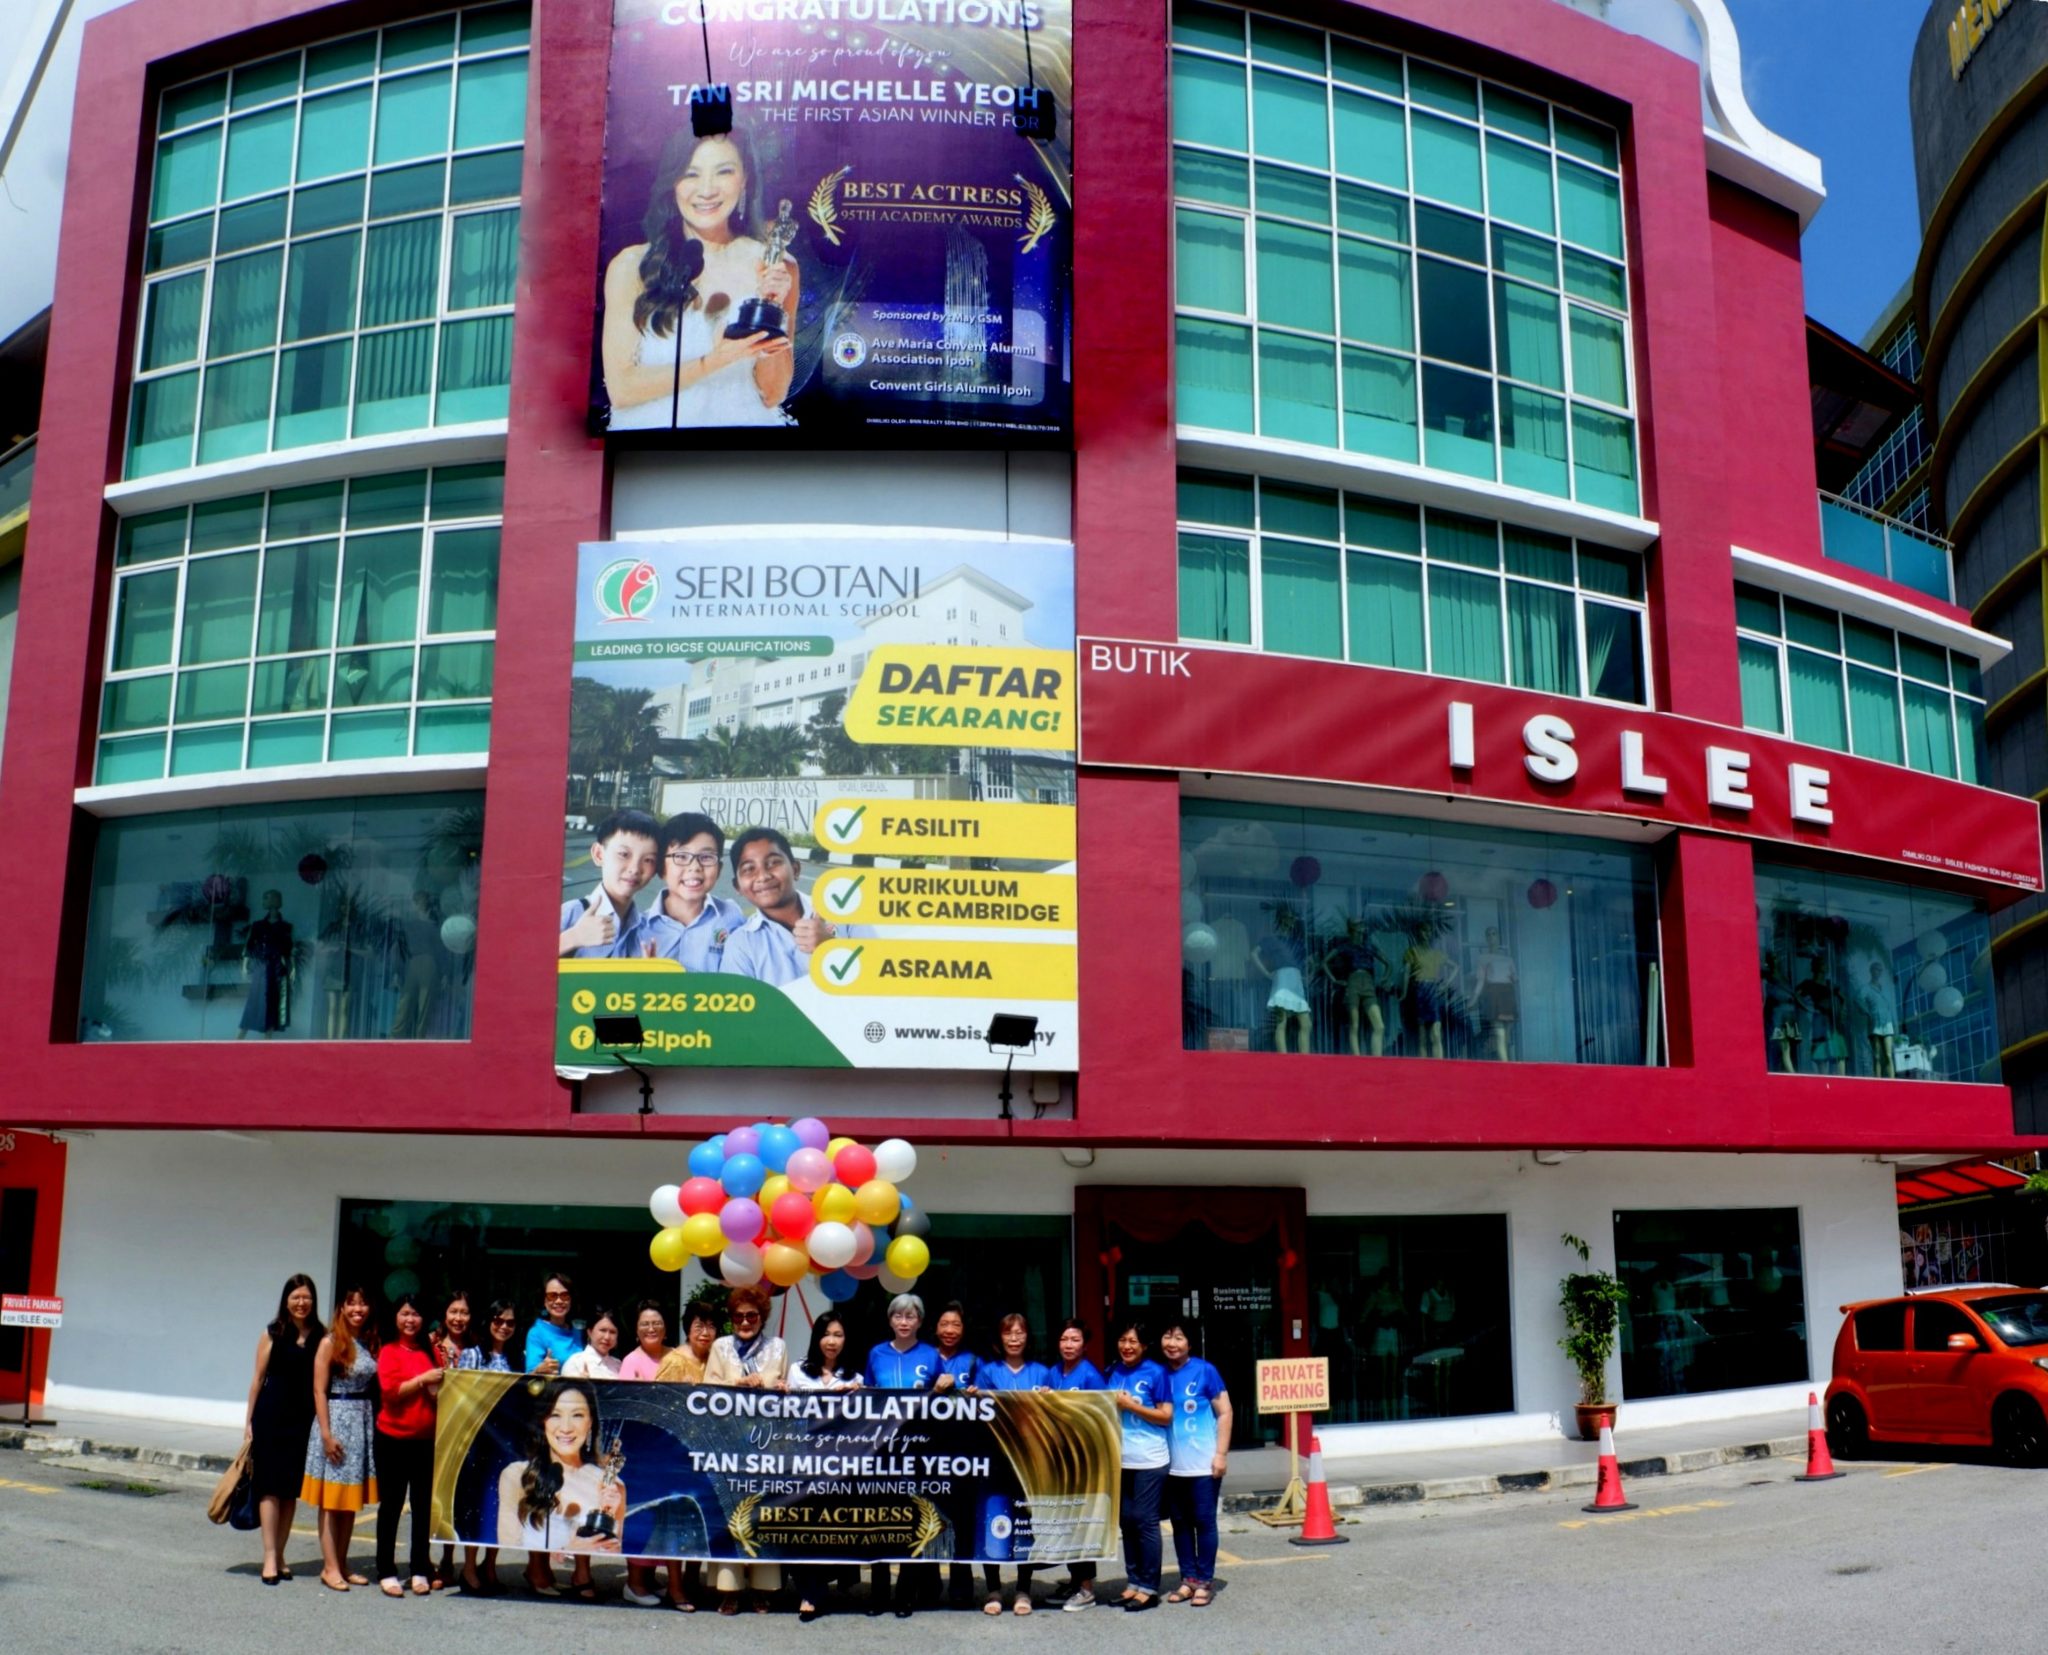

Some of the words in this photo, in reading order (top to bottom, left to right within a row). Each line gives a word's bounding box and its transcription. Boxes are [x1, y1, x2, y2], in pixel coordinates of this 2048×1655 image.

[661, 0, 1040, 27] CONGRATULATIONS
[728, 37, 768, 67] We
[772, 47, 807, 58] are
[808, 46, 829, 63] so
[831, 38, 889, 66] proud
[667, 82, 727, 106] TAN
[736, 80, 783, 102] SRI
[792, 79, 947, 103] MICHELLE
[954, 81, 1039, 109] YEOH
[760, 107, 797, 122] THE
[804, 107, 854, 122] FIRST
[858, 106, 914, 123] ASIAN
[920, 108, 996, 126] WINNER
[843, 182, 905, 199] BEST
[911, 183, 1023, 206] ACTRESS
[841, 209, 876, 222] 95TH
[879, 210, 957, 224] ACADEMY
[960, 212, 1023, 229] AWARDS
[872, 310, 931, 323] Sponsored
[932, 311, 945, 324] by
[953, 313, 976, 326] May
[978, 313, 1003, 325] GSM
[872, 338, 896, 350] Ave
[898, 338, 933, 350] Maria
[936, 340, 988, 352] Convent
[990, 342, 1036, 356] Alumni
[872, 353, 943, 366] Association
[946, 354, 975, 368] Ipoh
[869, 380, 921, 392] Convent
[924, 381, 953, 393] Girls
[955, 382, 1001, 395] Alumni
[1003, 384, 1033, 398] Ipoh
[675, 565, 753, 600] SERI
[766, 564, 920, 600] BOTANI
[672, 603, 830, 618] INTERNATIONAL
[840, 602, 920, 618] SCHOOL
[591, 643, 643, 656] LEADING
[646, 641, 664, 654] TO
[666, 641, 704, 654] IGCSE
[707, 640, 811, 654] QUALIFICATIONS
[1090, 645, 1192, 678] BUTIK
[878, 662, 1062, 700] DAFTAR
[877, 704, 1062, 733] SEKARANG!
[1448, 701, 1833, 825] ISLEE
[880, 817, 980, 839] FASILITI
[879, 877, 1018, 898] KURIKULUM
[879, 900, 914, 920] UK
[919, 899, 1060, 923] CAMBRIDGE
[879, 959, 992, 980] ASRAMA
[605, 993, 636, 1012] 05
[642, 993, 688, 1012] 226
[694, 993, 756, 1013] 2020
[1213, 1287, 1249, 1295] Business
[1213, 1295, 1234, 1303] Open
[17, 1314, 41, 1324] ISLEE
[1262, 1363, 1324, 1381] PRIVATE
[1262, 1382, 1324, 1401] PARKING
[686, 1391, 996, 1422] CONGRATULATIONS
[750, 1423, 782, 1450] We
[784, 1432, 811, 1443] are
[814, 1432, 834, 1448] so
[834, 1425, 881, 1451] proud
[883, 1425, 901, 1452] of
[900, 1433, 931, 1453] you
[688, 1451, 738, 1473] TAN
[745, 1453, 784, 1474] SRI
[792, 1455, 915, 1476] MICHELLE
[921, 1455, 990, 1477] YEOH
[727, 1478, 758, 1494] THE
[763, 1479, 803, 1495] FIRST
[806, 1480, 851, 1495] ASIAN
[856, 1481, 917, 1495] WINNER
[921, 1480, 951, 1495] FOR
[759, 1506, 812, 1523] BEST
[817, 1506, 913, 1523] ACTRESS
[756, 1532, 789, 1544] 95TH
[790, 1533, 859, 1545] ACADEMY
[860, 1532, 913, 1545] AWARDS
